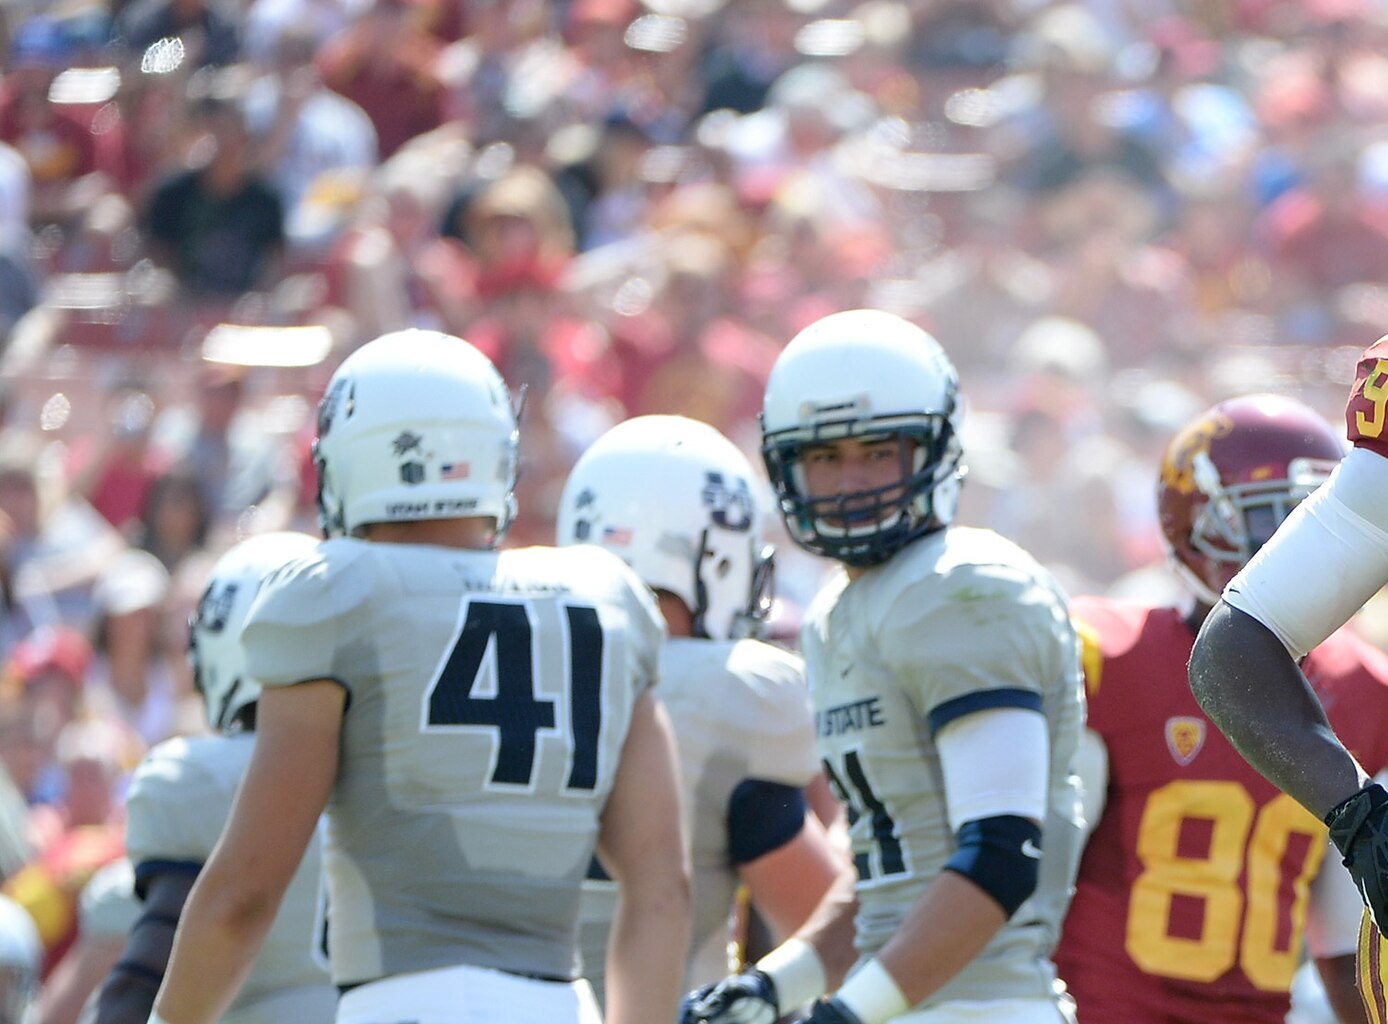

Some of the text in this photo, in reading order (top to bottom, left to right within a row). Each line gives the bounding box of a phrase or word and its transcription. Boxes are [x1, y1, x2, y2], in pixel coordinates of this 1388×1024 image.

[421, 594, 606, 796] 41
[822, 696, 885, 738] STATE
[1125, 779, 1330, 993] 80
